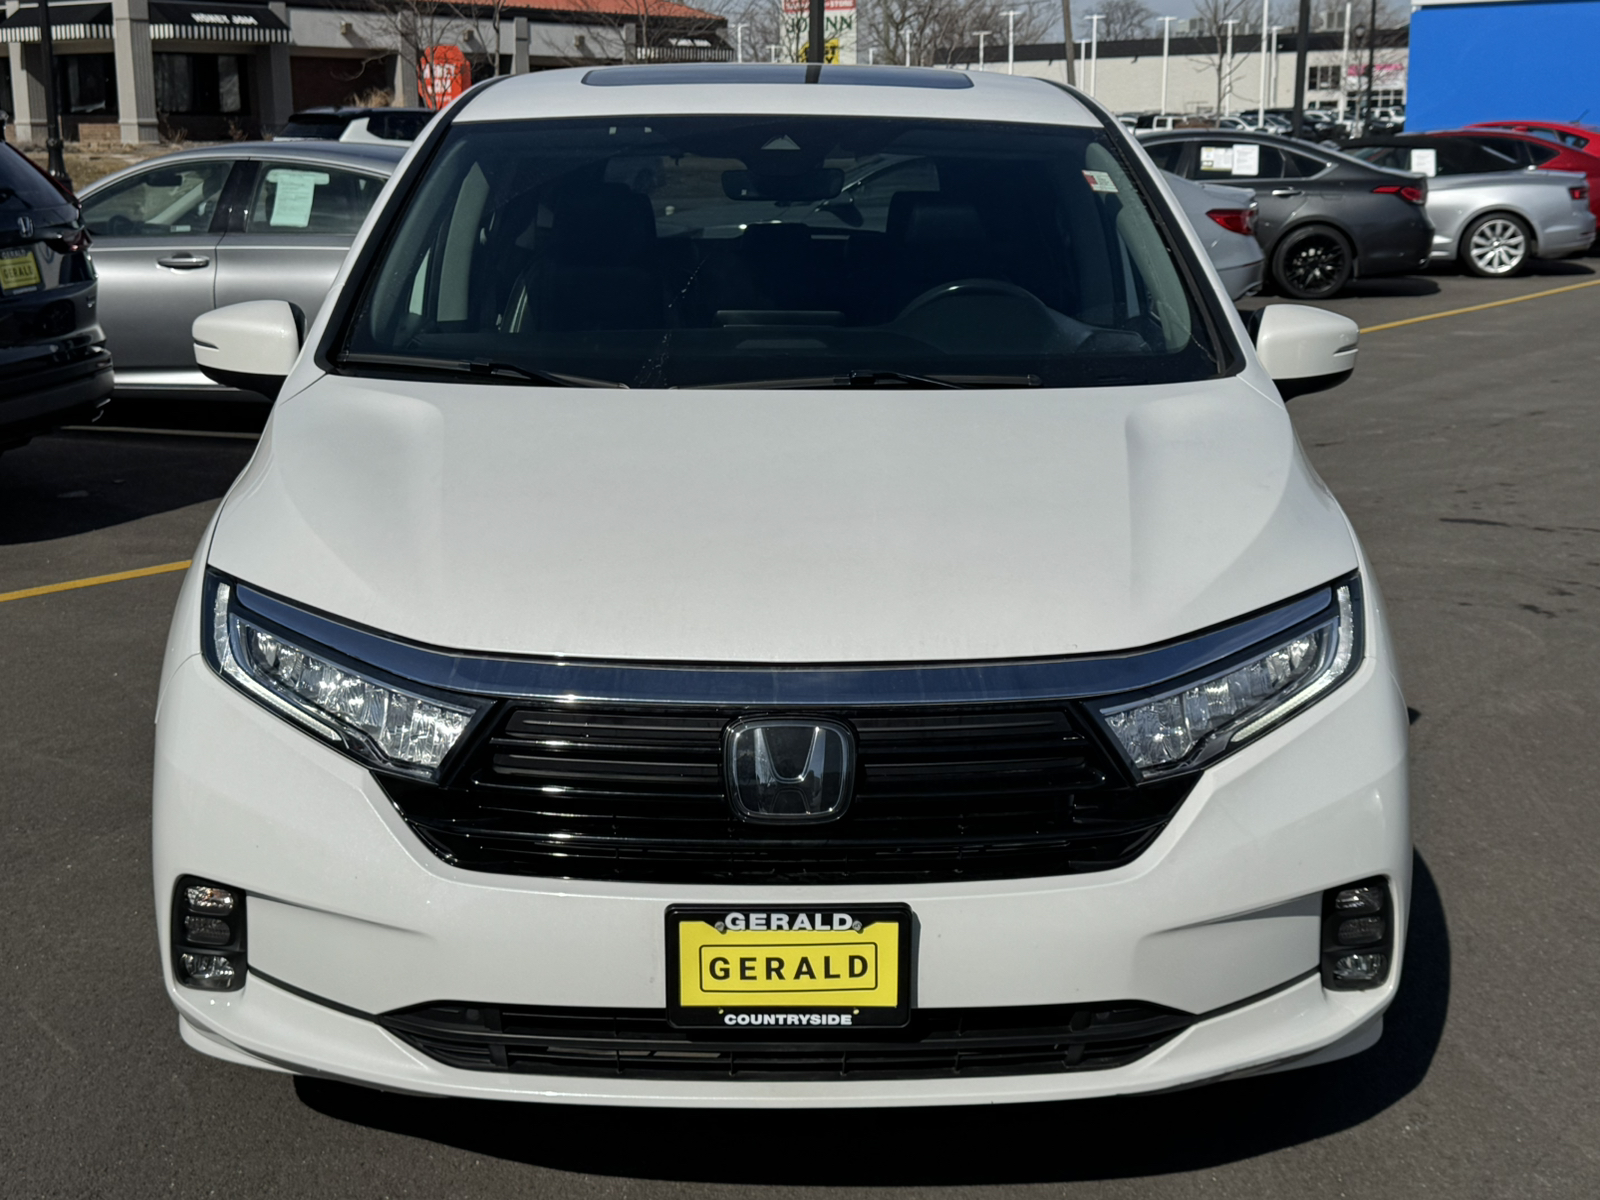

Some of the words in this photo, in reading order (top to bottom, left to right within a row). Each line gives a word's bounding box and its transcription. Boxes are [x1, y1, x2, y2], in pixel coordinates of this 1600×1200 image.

[786, 16, 852, 34] JONN
[724, 912, 853, 931] GERALD
[709, 955, 869, 981] GERALD
[724, 1014, 853, 1025] COUNTRYSIDE
